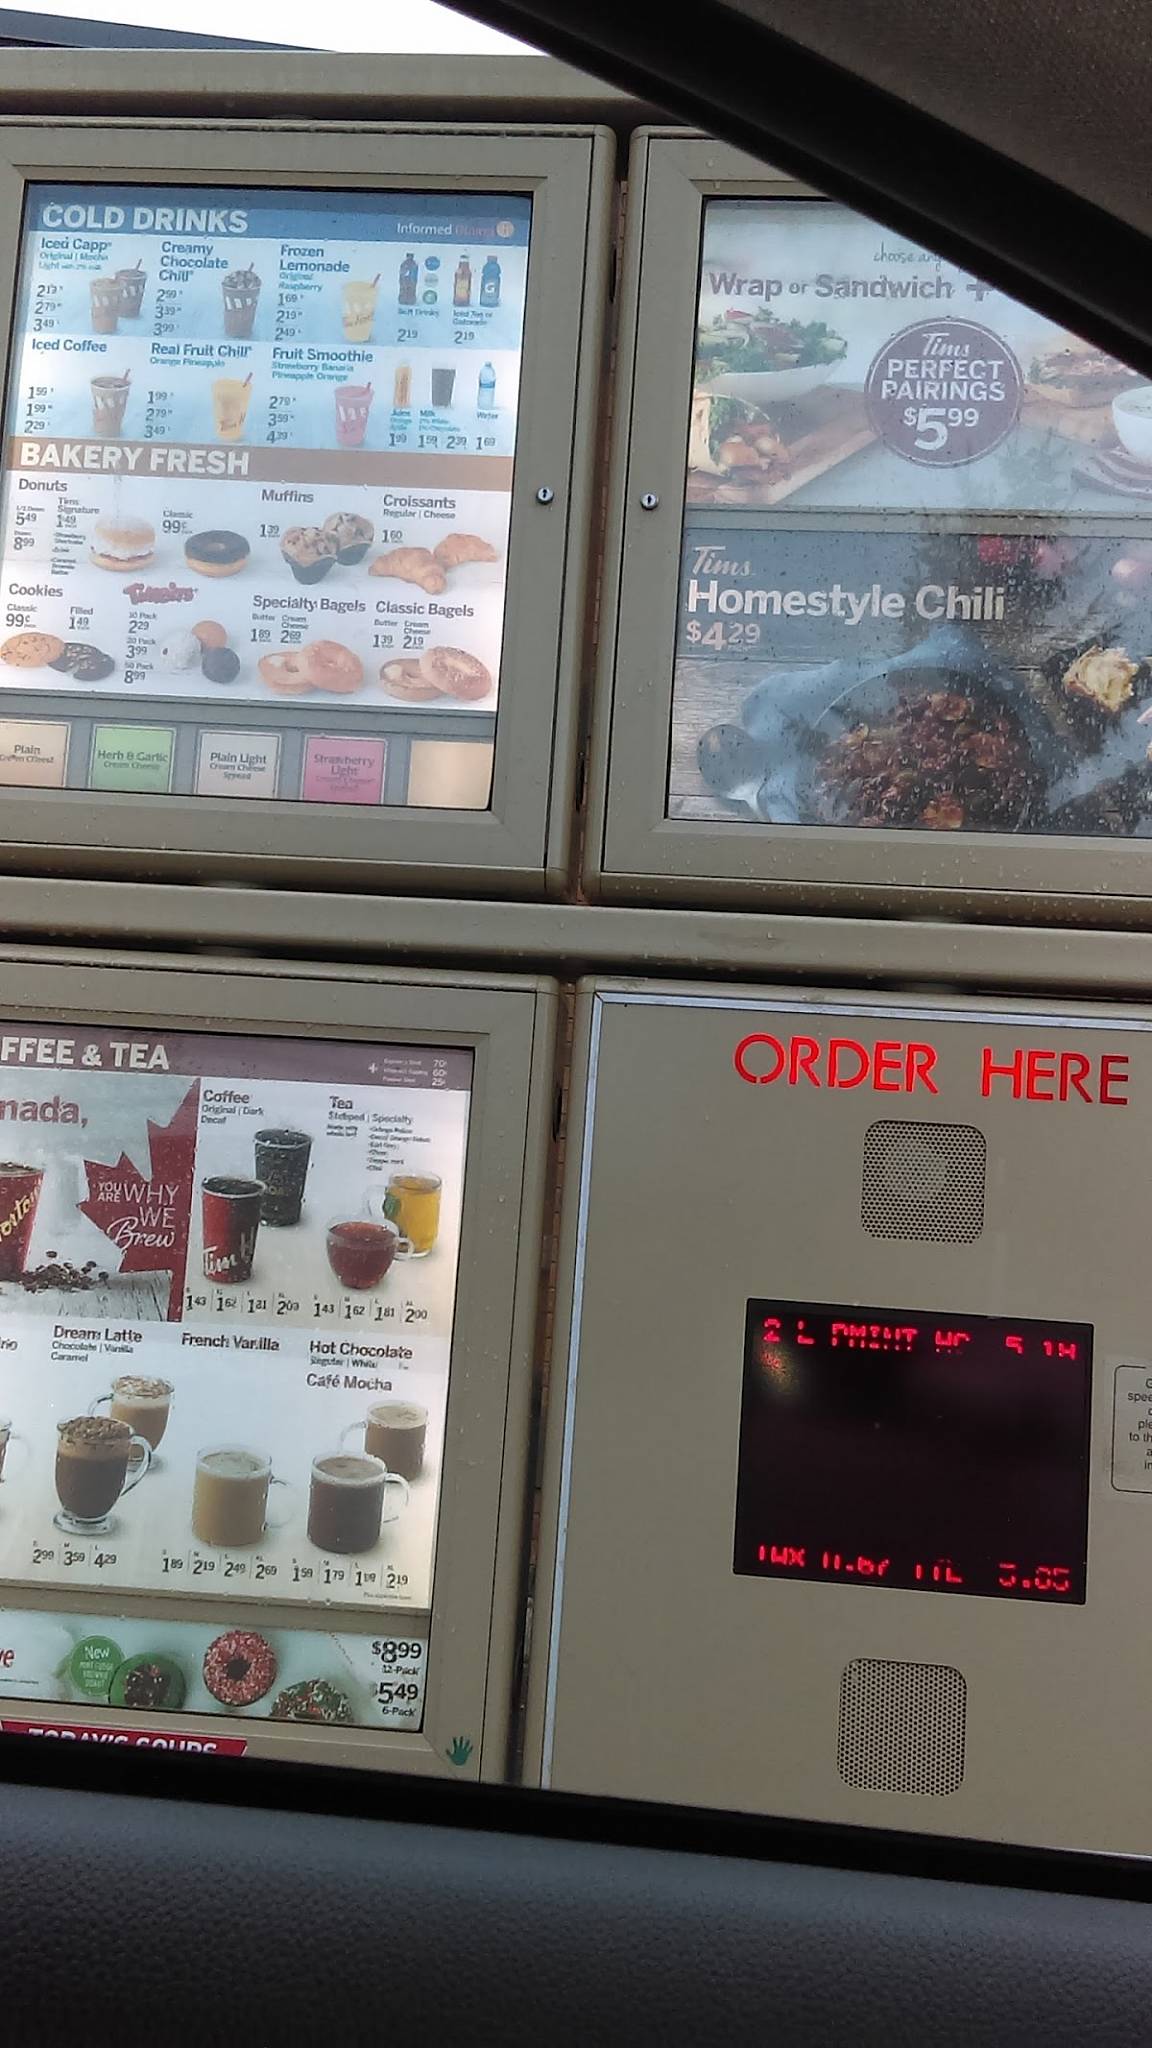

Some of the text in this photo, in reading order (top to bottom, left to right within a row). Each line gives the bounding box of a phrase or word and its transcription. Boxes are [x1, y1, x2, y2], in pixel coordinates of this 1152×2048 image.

[42, 204, 249, 234] COLD DRINKS
[397, 222, 453, 236] Informed
[40, 237, 69, 250] Iced
[161, 241, 214, 257] Creamy
[281, 244, 325, 258] Frozen
[873, 241, 914, 264] choose
[160, 255, 229, 269] Chocolate
[279, 259, 351, 273] Lemonade
[709, 272, 955, 301] Wrap or Sandwich
[32, 338, 108, 353] Iced Coffee
[151, 343, 214, 357] Real Fruit
[922, 332, 971, 358] Tims
[149, 356, 181, 368] Orange
[272, 347, 374, 363] Fruit Smoothie
[271, 361, 355, 373] Strawberry Banana
[886, 359, 1004, 381] PERFECT
[271, 371, 349, 384] Pineapple Orange
[880, 379, 1006, 402] PAIRINGS
[19, 441, 250, 476] BAKERY FRESH
[18, 478, 68, 492] Donuts
[261, 489, 314, 503] Muffins
[383, 493, 457, 510] Croissants
[57, 504, 101, 515] Signature
[162, 509, 193, 519] Classic
[383, 508, 457, 521] Regular Cheese
[691, 545, 752, 577] Tims
[8, 582, 64, 597] Cookies
[6, 603, 38, 613] Classic
[252, 595, 367, 614] Specialty Bagels
[686, 578, 1006, 626] Homestyle Chili
[69, 606, 94, 616] Filled
[139, 612, 158, 621] Pack
[375, 600, 475, 619] Classic Bagels
[251, 613, 276, 622] Butter
[281, 614, 308, 624] Cream
[373, 619, 398, 628] Butter
[403, 620, 430, 629] Cream
[281, 622, 309, 631] Cheese
[403, 627, 431, 636] Cheese
[137, 637, 156, 647] Pack
[136, 662, 155, 672] Pack
[14, 743, 41, 756] Plain
[97, 749, 124, 761] Herb
[136, 751, 168, 763] Garlic
[209, 751, 267, 767] Plain Light
[313, 752, 376, 768] Strawberry
[331, 765, 359, 778] Light
[82, 1045, 103, 1068] &
[109, 1042, 170, 1071] TEA
[733, 1032, 1130, 1107] ORDER HERE
[203, 1089, 250, 1105] Coffee
[329, 1095, 354, 1110] Tea
[202, 1104, 264, 1117] Original Dark
[201, 1114, 227, 1125] Decaf
[371, 1113, 412, 1126] Specialty
[99, 1182, 180, 1208] YOU WHY
[97, 1192, 176, 1229] ARE WE
[106, 1216, 177, 1251] Brew
[53, 1324, 143, 1343] Dream Latte
[764, 1318, 781, 1343] 2
[797, 1321, 815, 1345] L
[51, 1340, 134, 1354] Chocolate Vanilla
[181, 1333, 280, 1352] French Vanilla
[310, 1340, 413, 1360] Hot Chocolate
[50, 1352, 89, 1363] Caramel
[306, 1373, 393, 1392] Café Mocha
[1129, 1431, 1140, 1443] to
[84, 1645, 110, 1660] New
[382, 1664, 420, 1676] 12-Pack
[383, 1705, 416, 1717] 6-Pack
